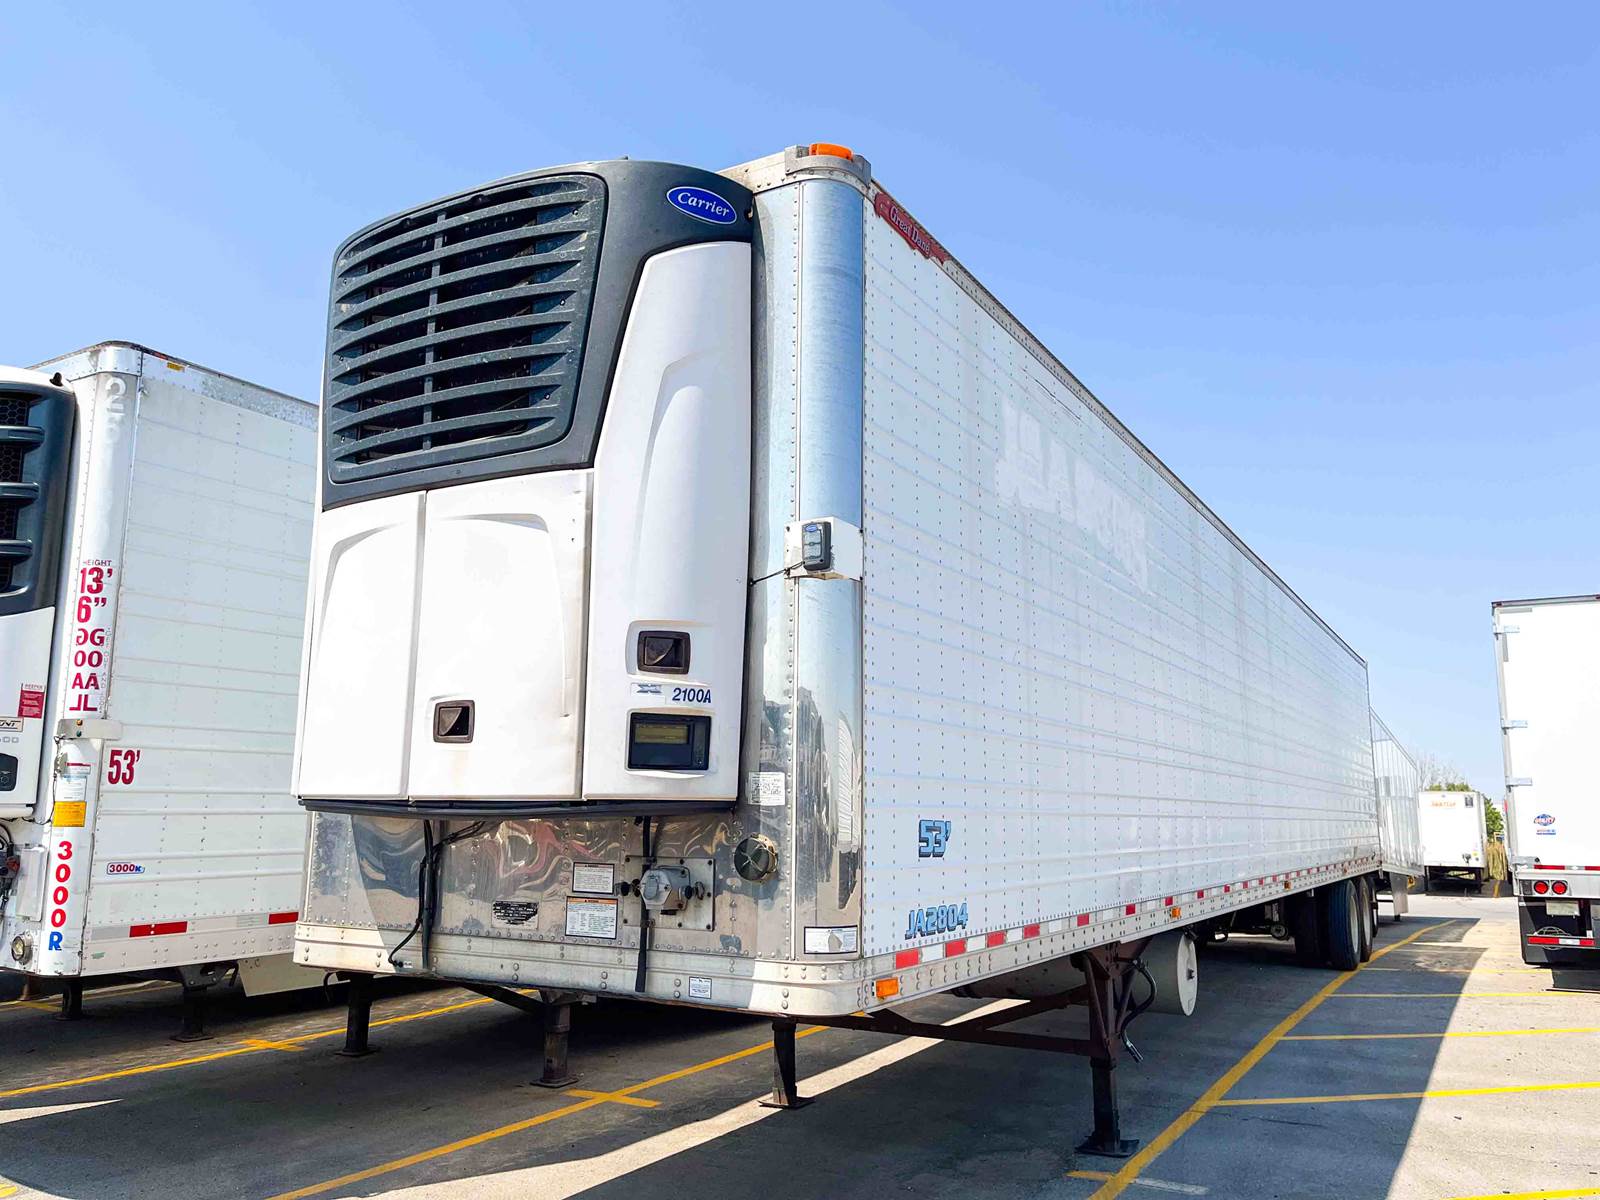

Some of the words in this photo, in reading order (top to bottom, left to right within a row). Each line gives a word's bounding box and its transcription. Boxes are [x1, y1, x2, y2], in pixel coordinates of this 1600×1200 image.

[678, 192, 729, 217] Carrier
[891, 206, 912, 237] Great
[80, 567, 113, 594] 13'
[672, 687, 711, 703] 2100A
[107, 750, 140, 785] 53'
[918, 819, 951, 857] 53'
[904, 902, 968, 940] JA2804
